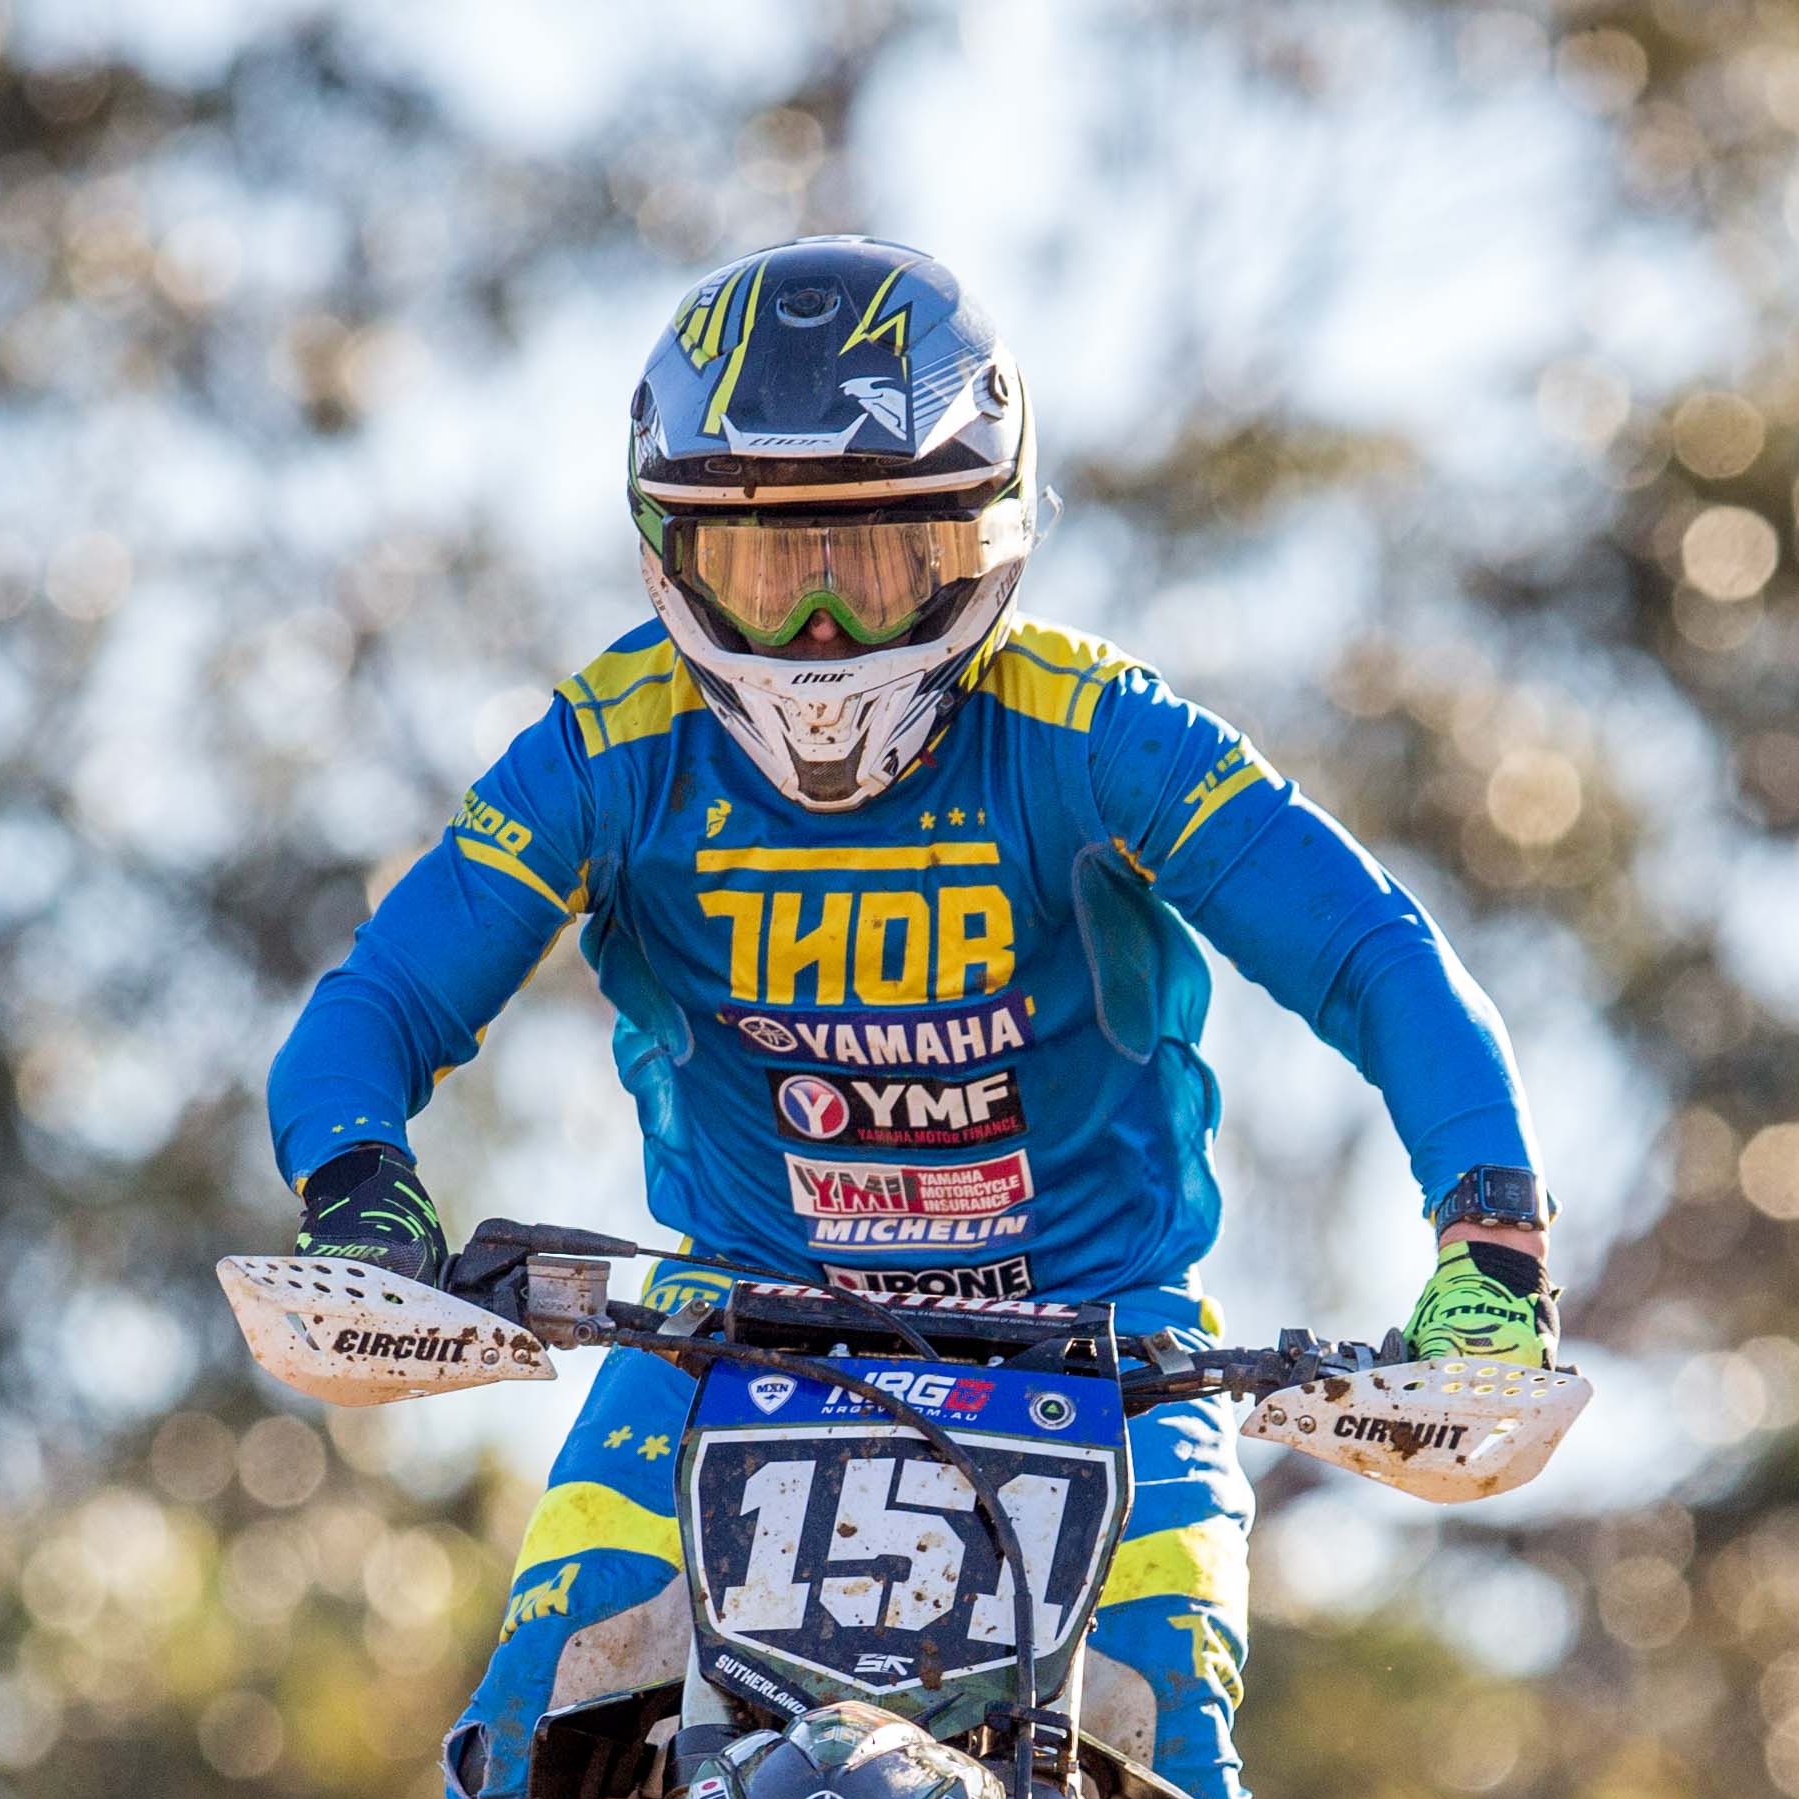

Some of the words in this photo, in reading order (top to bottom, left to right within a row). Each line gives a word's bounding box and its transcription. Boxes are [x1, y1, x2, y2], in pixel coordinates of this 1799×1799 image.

[790, 671, 855, 685] thor
[697, 884, 1016, 1006] THOR
[795, 1005, 1025, 1066] YAMAHA
[850, 1071, 1010, 1130] YMF
[857, 1126, 911, 1143] YAMAHA
[913, 1129, 959, 1145] MOTOR
[962, 1115, 1020, 1141] FINANCE
[806, 1167, 909, 1214] YMI
[916, 1169, 984, 1187] YAMAHA
[920, 1174, 1021, 1200] MOTORCYCLE
[922, 1192, 1013, 1214] INSURANCE
[815, 1215, 1029, 1243] MICHELIN
[1439, 1302, 1531, 1328] THOR
[333, 1327, 472, 1365] CIRCUIT
[722, 1457, 1071, 1649] 151
[715, 1653, 809, 1715] SUTHERLAND
